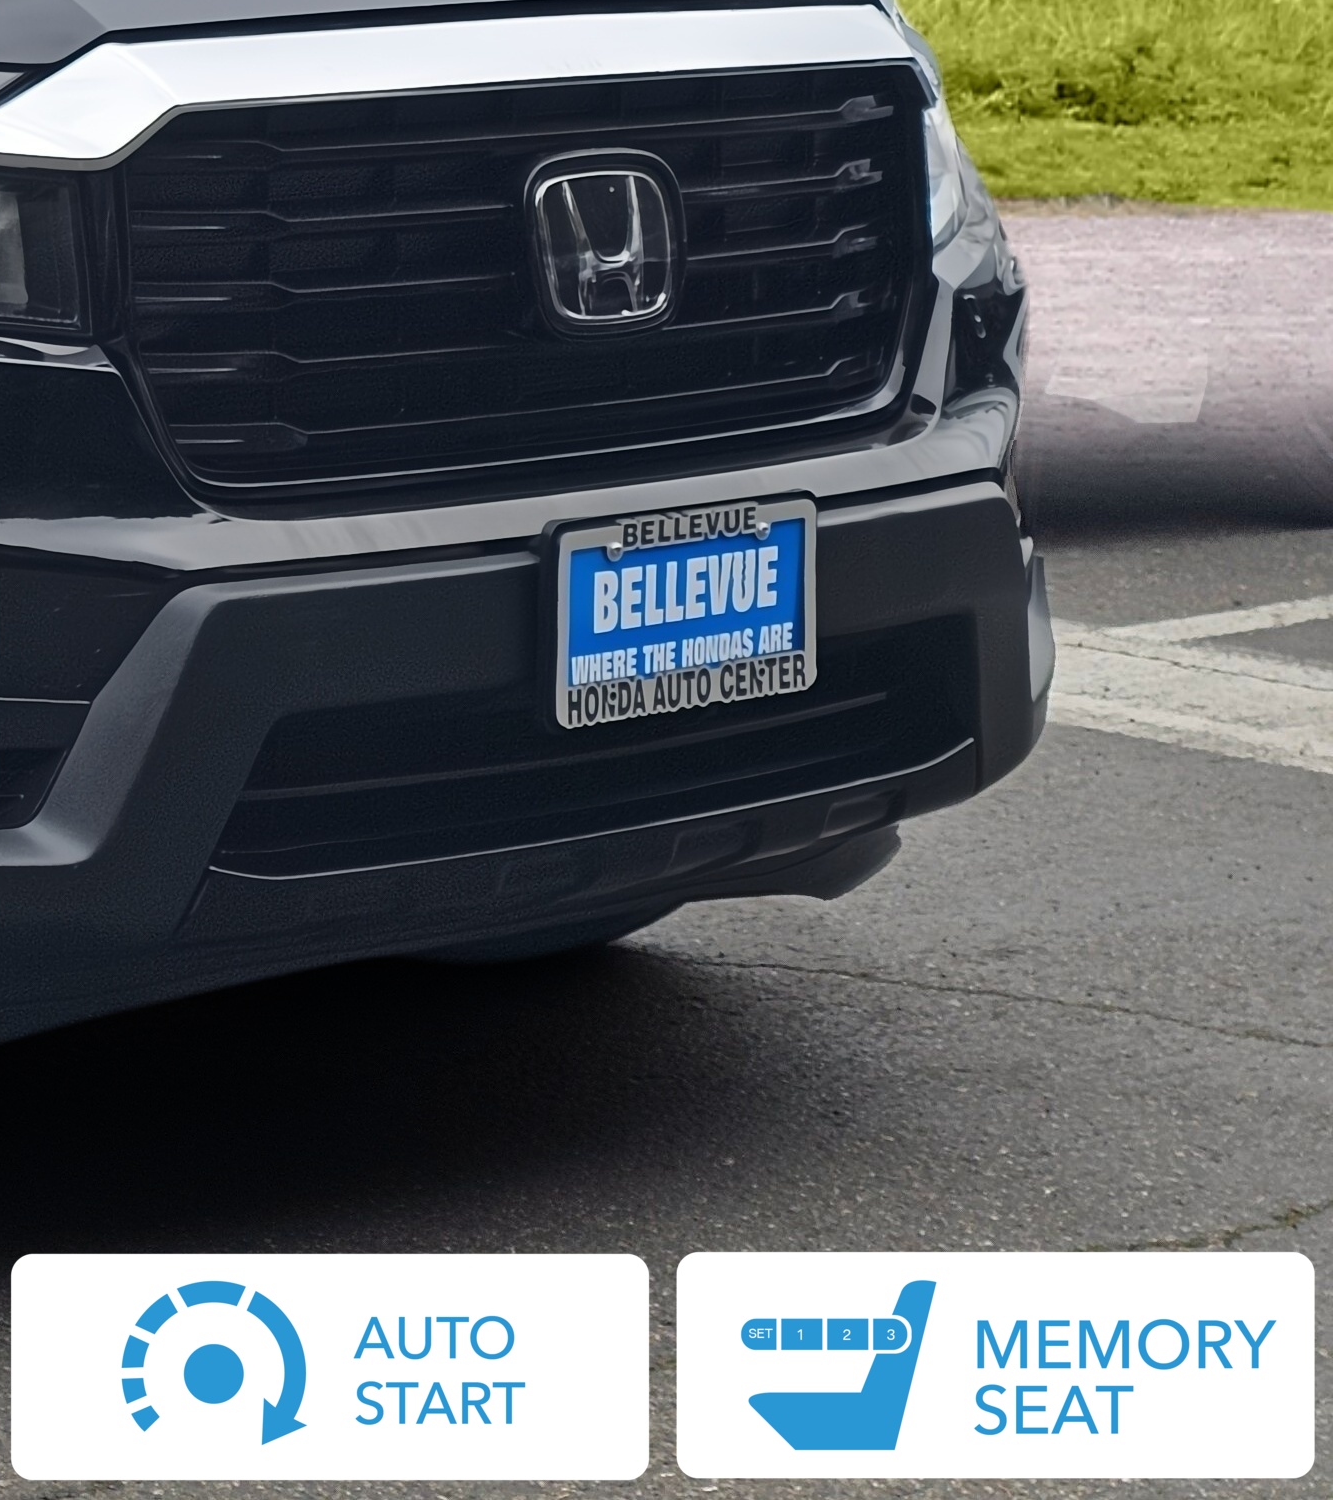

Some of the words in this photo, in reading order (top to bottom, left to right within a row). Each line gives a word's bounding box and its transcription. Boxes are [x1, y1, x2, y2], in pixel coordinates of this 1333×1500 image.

[622, 506, 757, 548] BELLEVUE
[593, 546, 779, 634] BELLEVUE
[571, 648, 638, 686] WHERE
[643, 641, 677, 675] THE
[682, 628, 754, 668] HONDAS
[758, 622, 794, 655] ARE
[567, 678, 646, 725] HONDA
[652, 668, 712, 711] AUTO
[719, 653, 806, 700] CENTER
